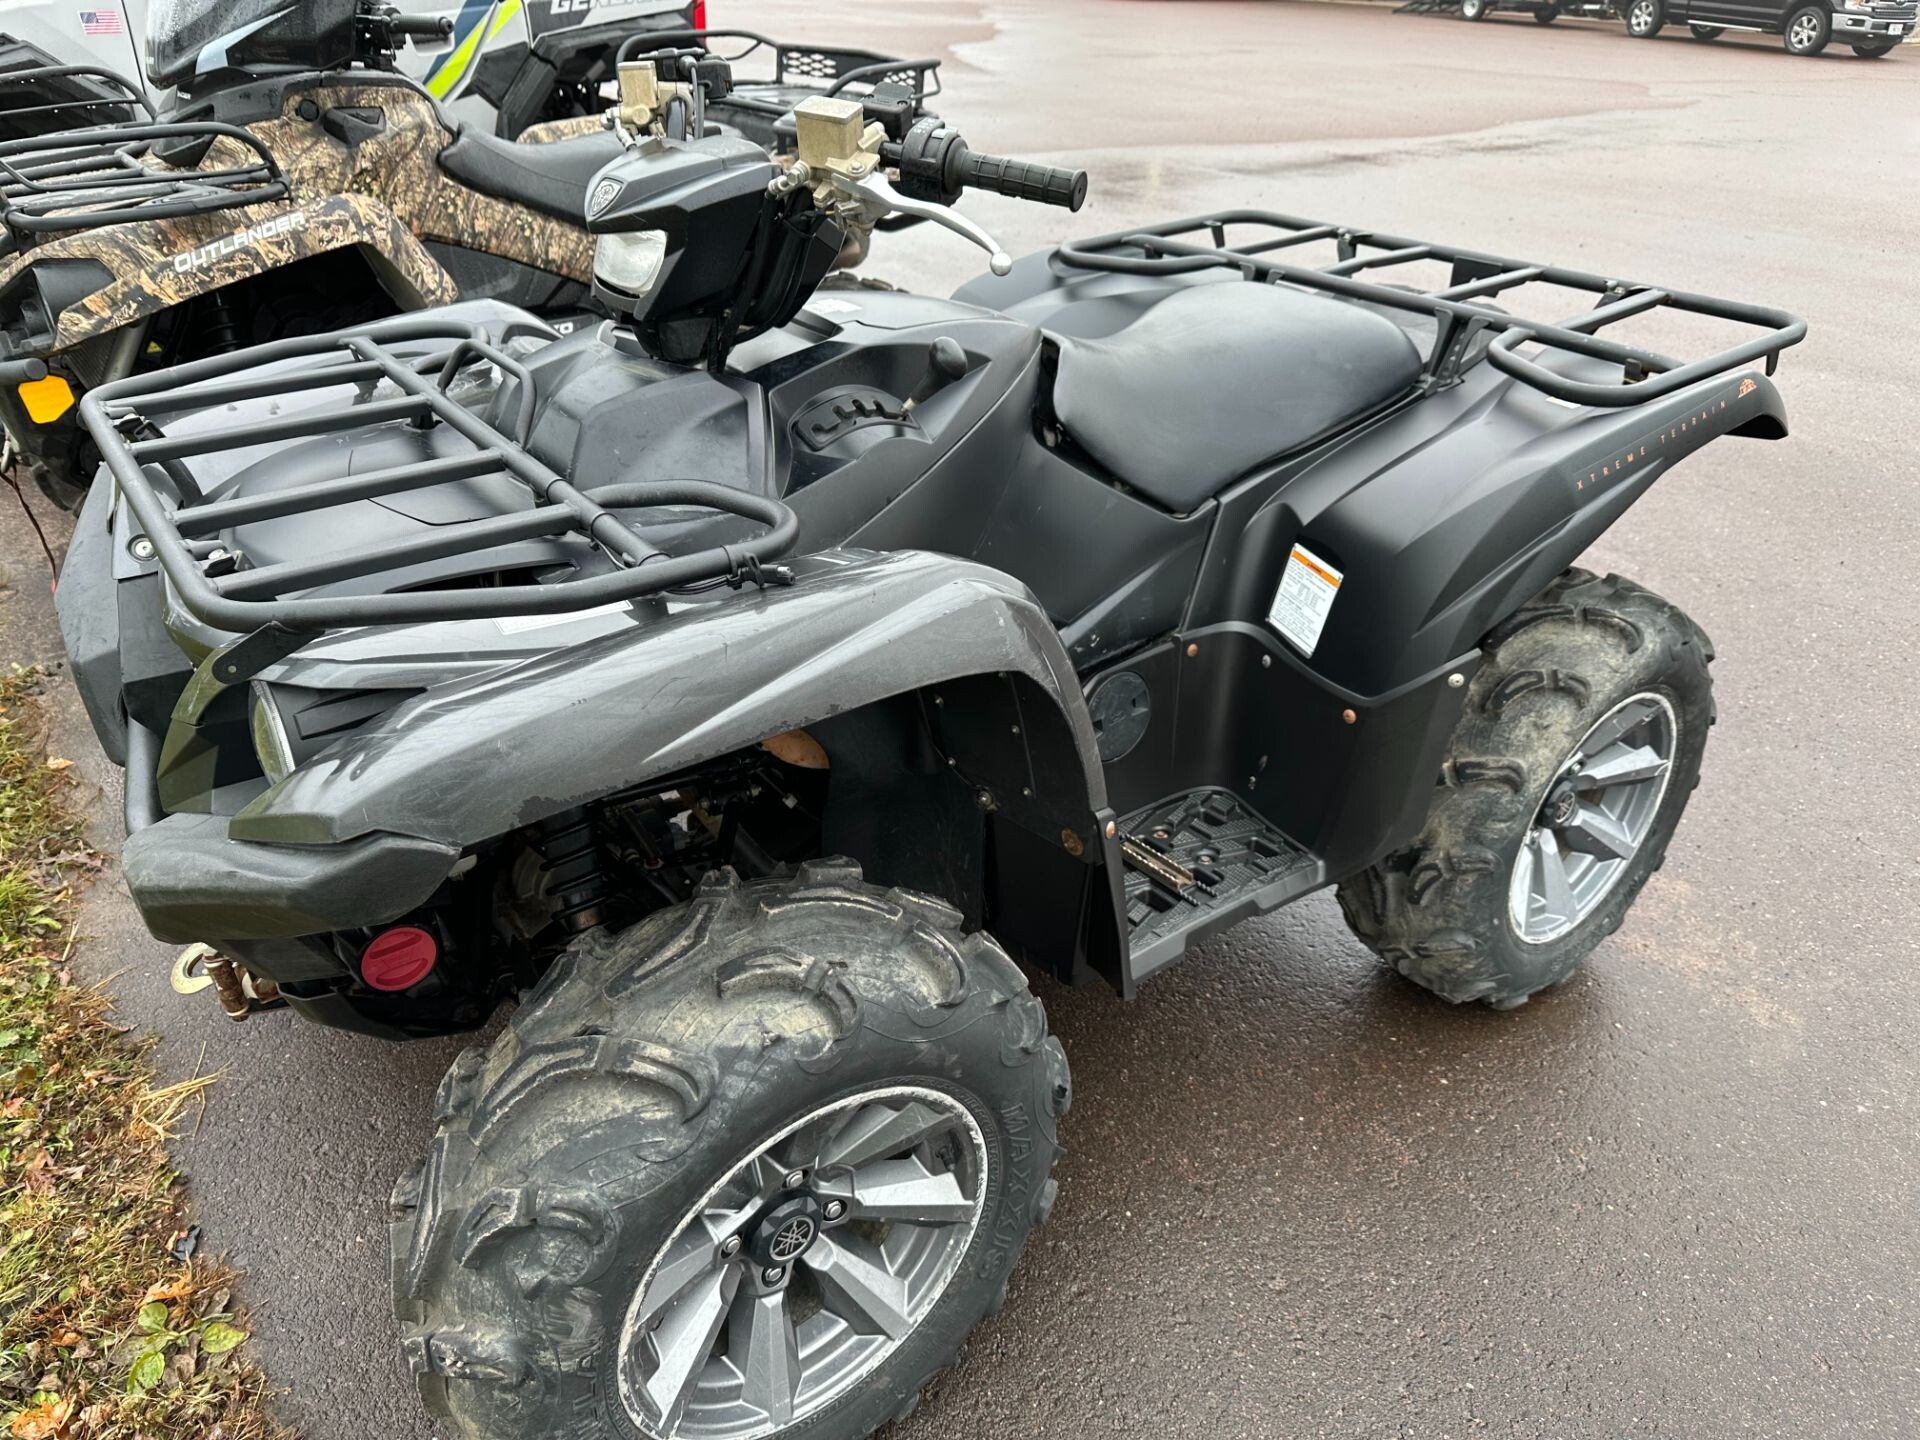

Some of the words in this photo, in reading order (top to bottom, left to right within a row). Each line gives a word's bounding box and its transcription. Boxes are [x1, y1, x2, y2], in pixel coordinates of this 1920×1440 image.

[174, 211, 305, 273] OUTLANDER
[1576, 446, 1646, 490] XTREME
[1659, 400, 1726, 443] TERRAIN
[977, 1102, 1033, 1280] MAXXIS
